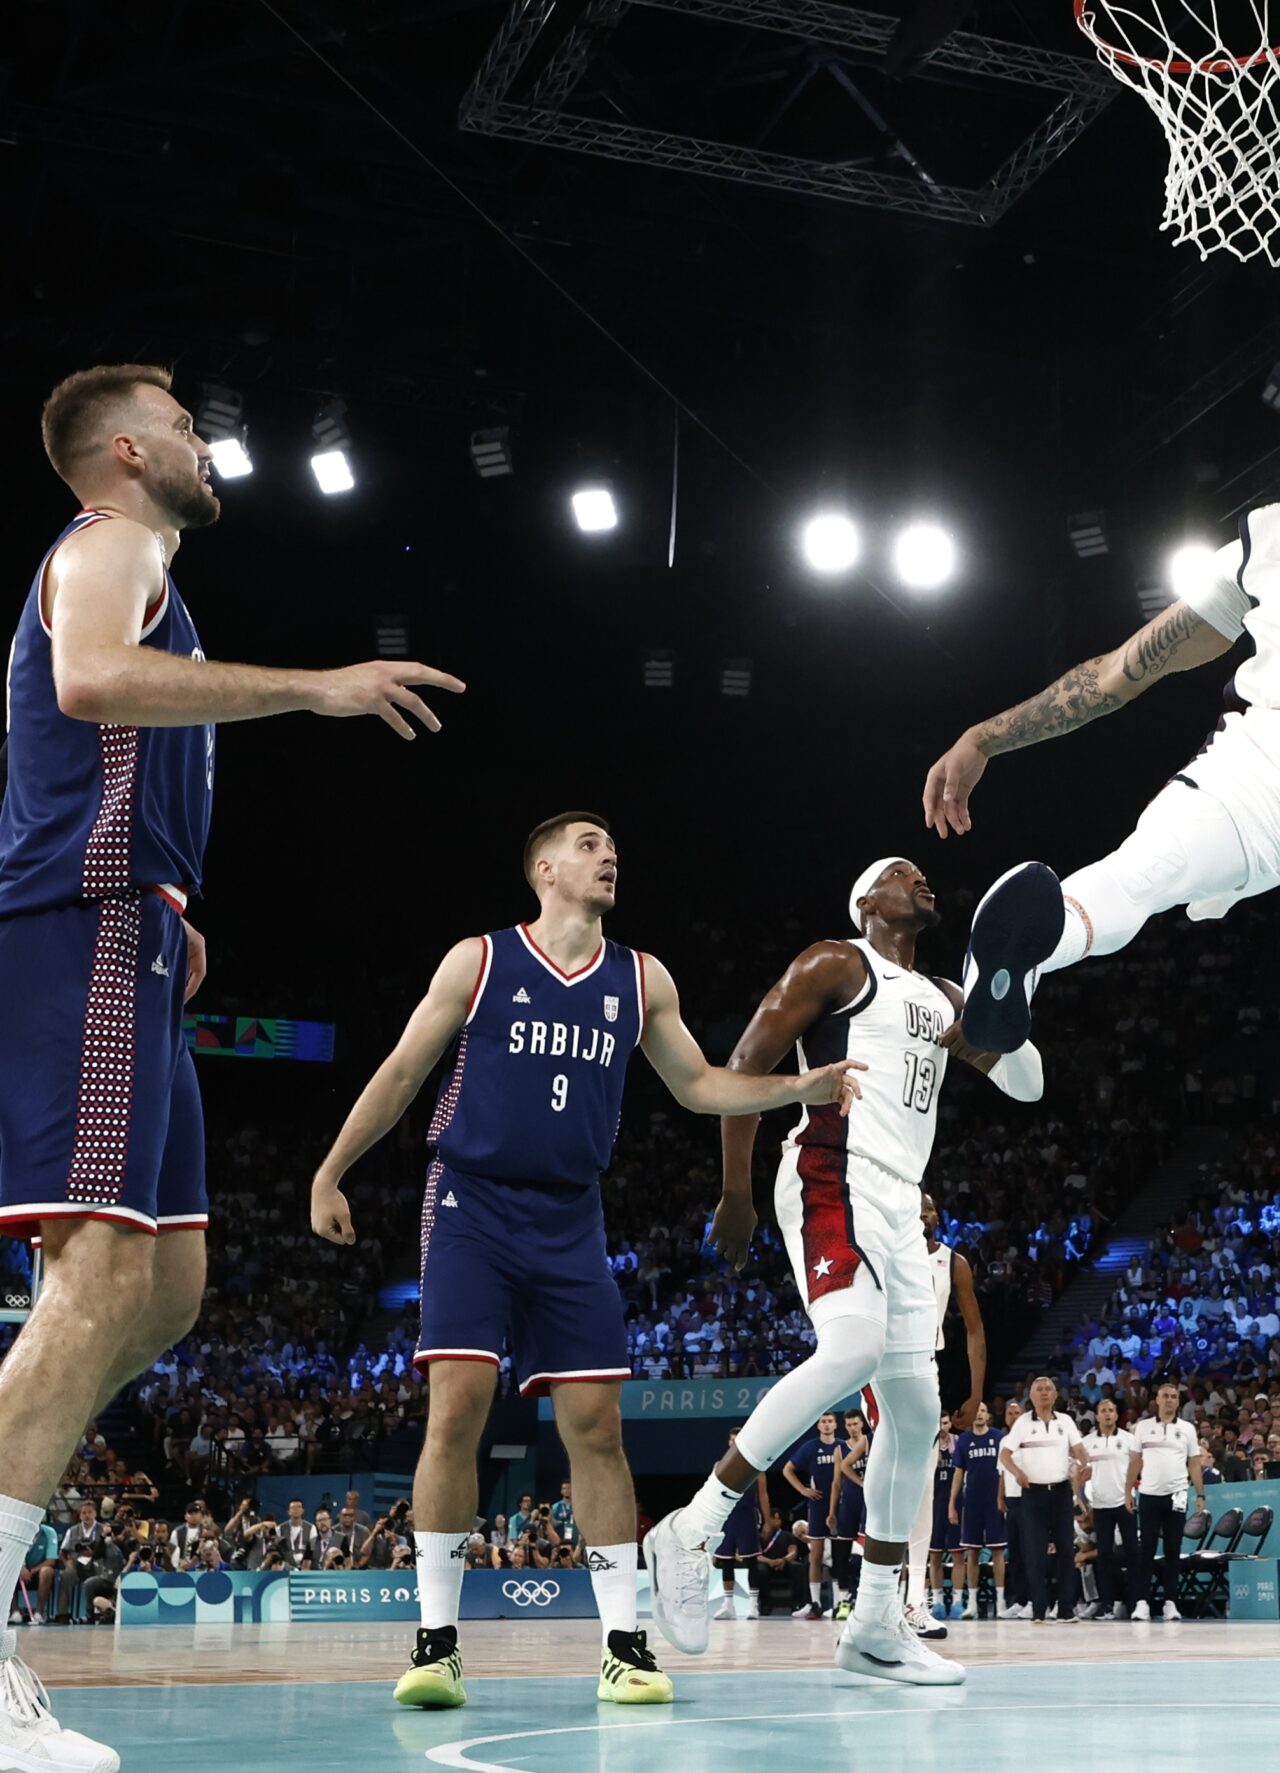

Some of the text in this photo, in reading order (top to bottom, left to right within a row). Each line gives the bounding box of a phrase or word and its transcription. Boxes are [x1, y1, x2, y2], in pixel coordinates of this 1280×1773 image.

[508, 1020, 616, 1068] SRBIJA
[904, 1000, 944, 1049] USA
[550, 1073, 569, 1113] 9
[903, 1051, 937, 1115] 13
[642, 1390, 724, 1411] PARIS
[304, 1587, 420, 1604] PARIS 202
